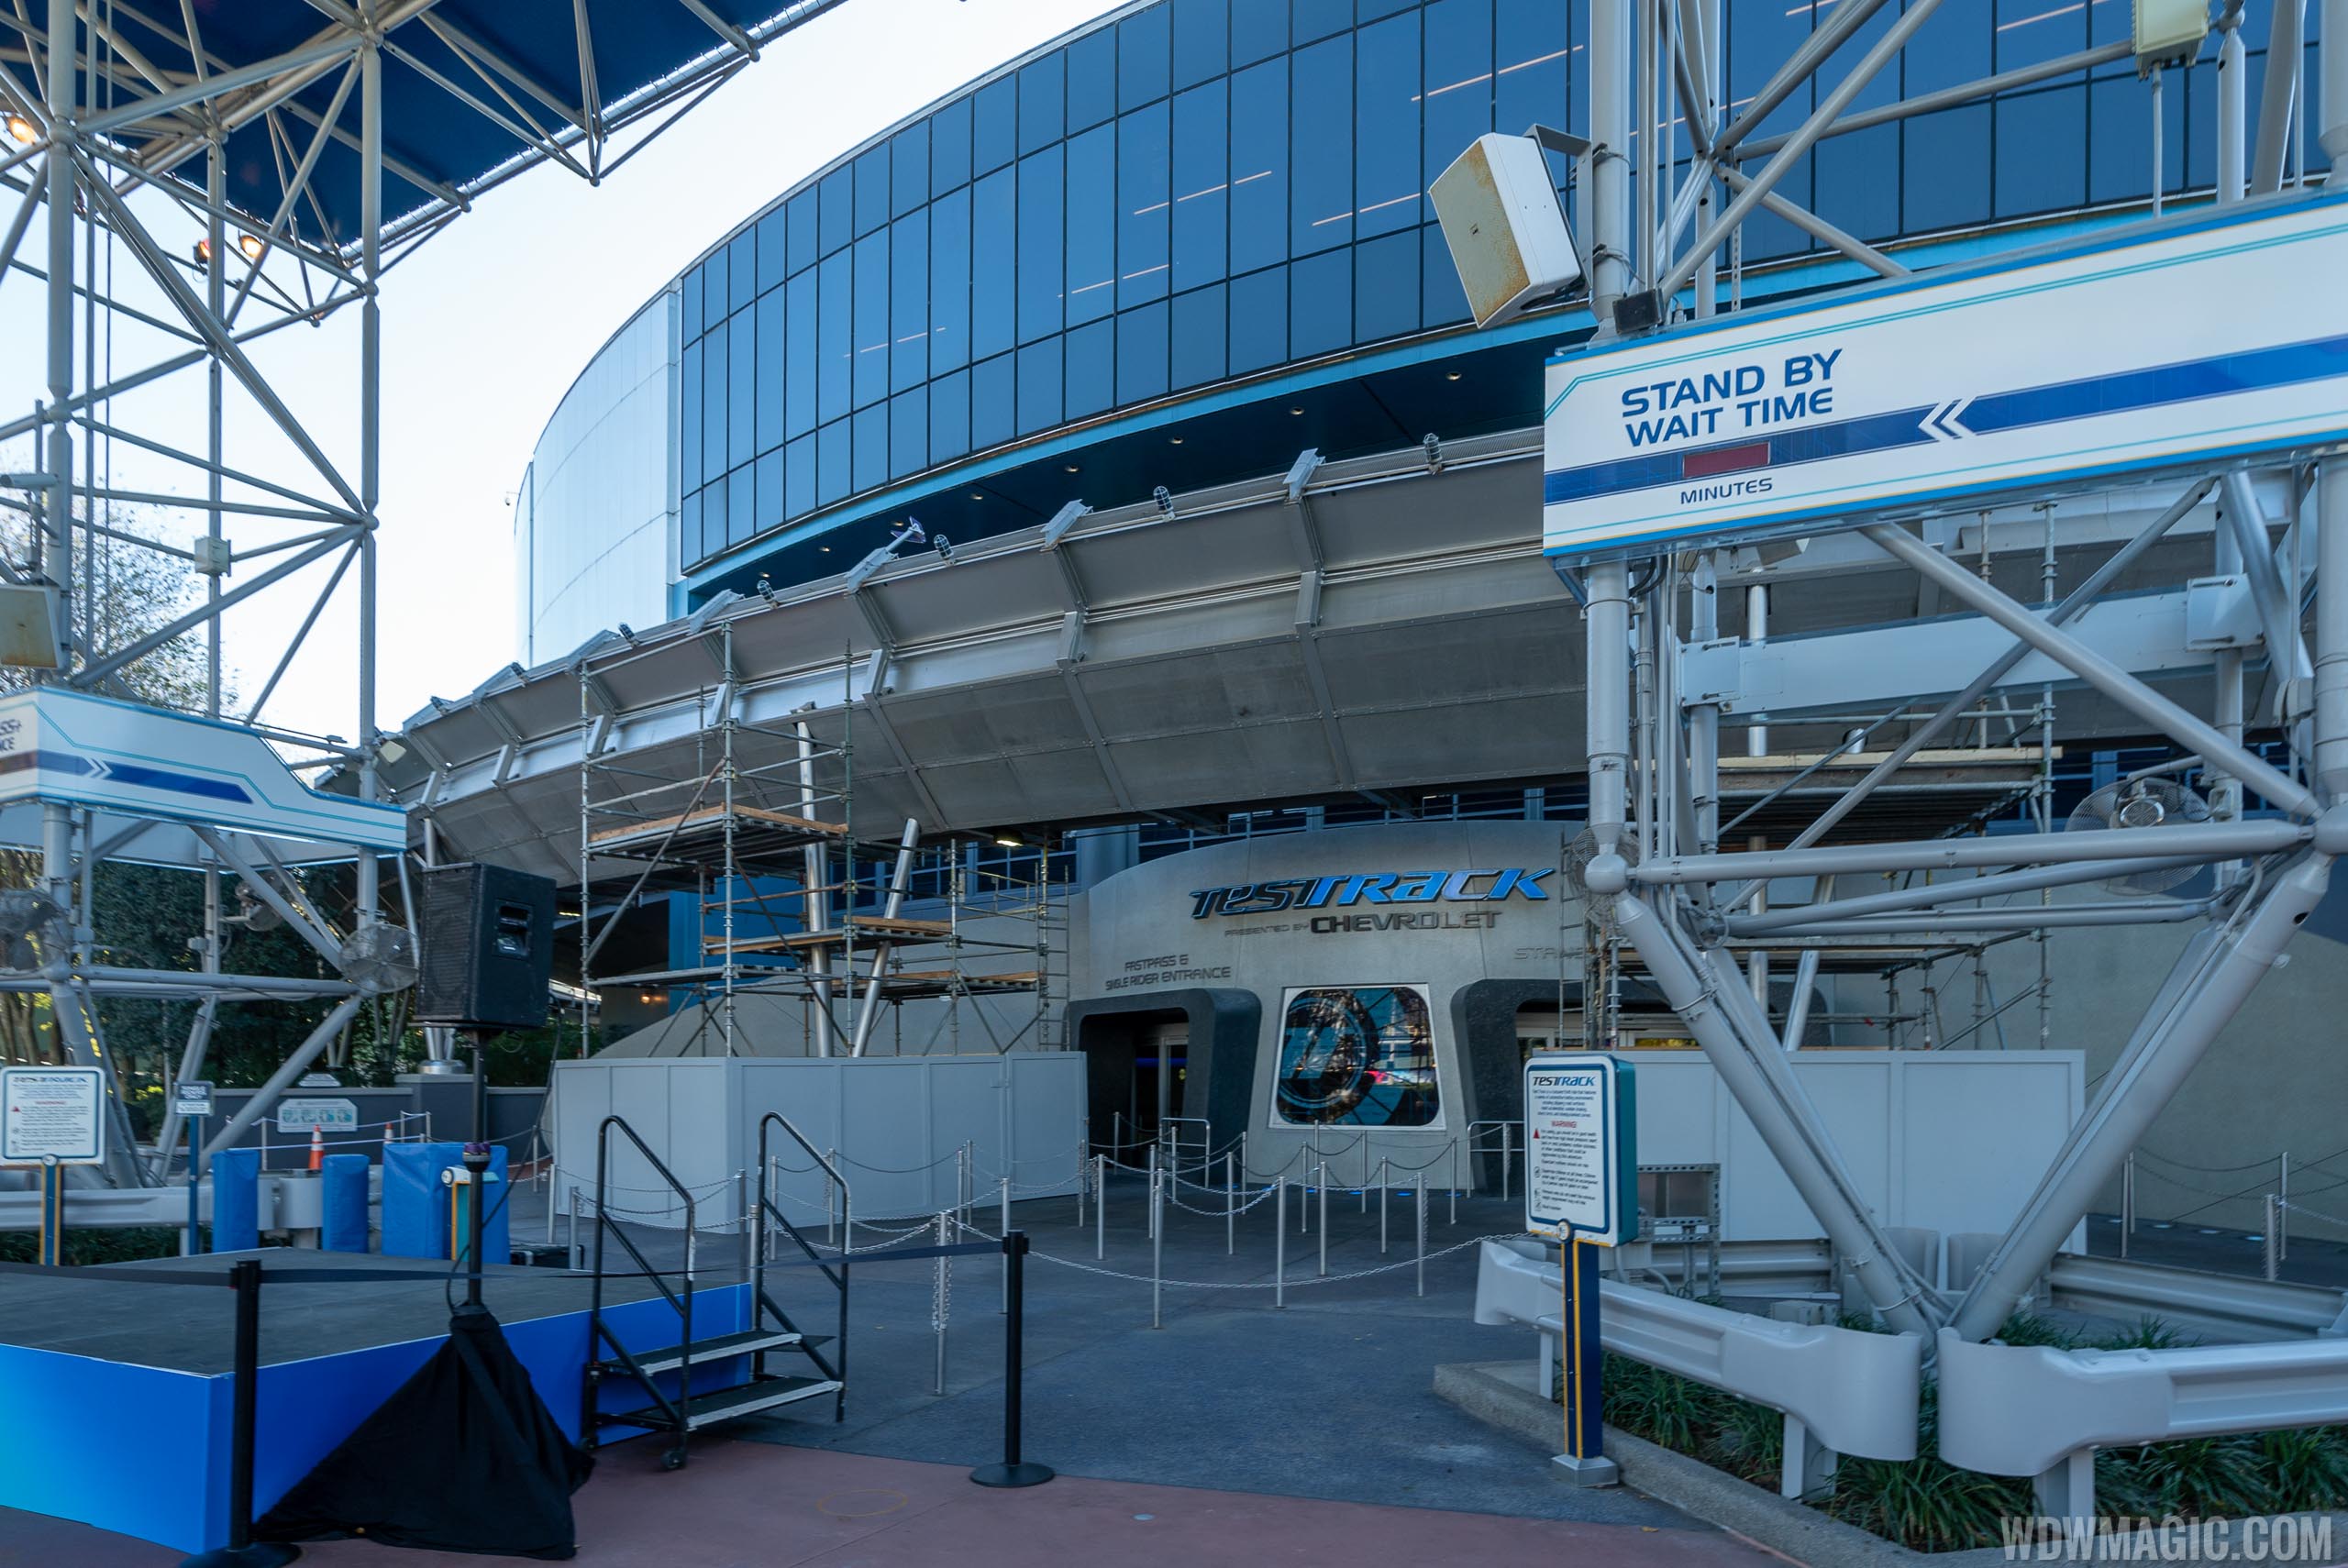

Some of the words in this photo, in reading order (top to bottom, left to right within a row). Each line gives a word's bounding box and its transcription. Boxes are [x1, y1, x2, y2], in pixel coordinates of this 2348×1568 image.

[1622, 365, 1766, 417] STAND
[1784, 348, 1843, 388] BY
[1625, 406, 1724, 447] WAIT
[1736, 386, 1833, 427] TIME
[1680, 477, 1773, 505] MINUTES
[1310, 911, 1503, 933] CHEVROLET
[1124, 955, 1177, 972] FASTPASS
[1129, 972, 1159, 987] RIDER
[1161, 966, 1231, 983] ENTRANCE
